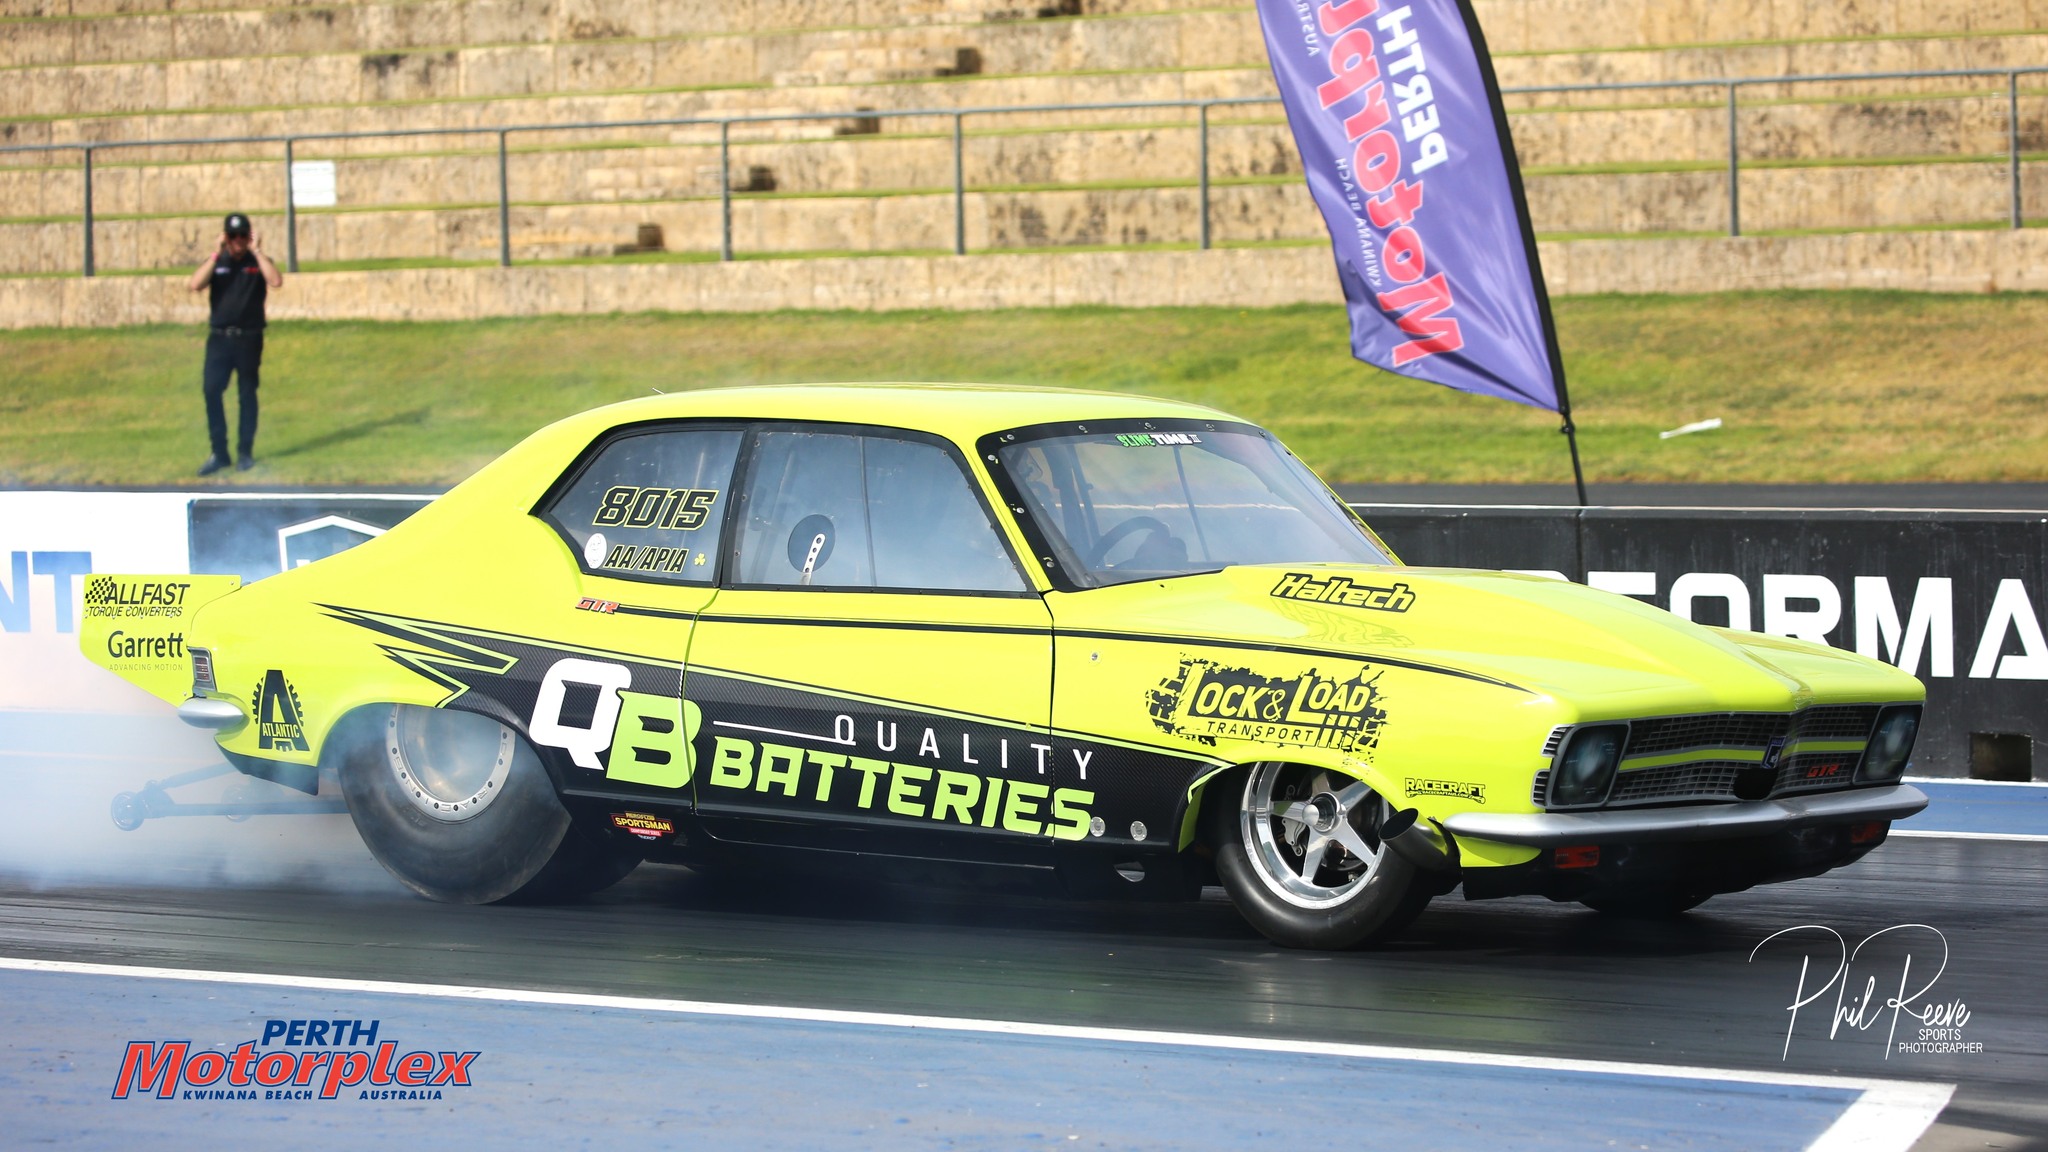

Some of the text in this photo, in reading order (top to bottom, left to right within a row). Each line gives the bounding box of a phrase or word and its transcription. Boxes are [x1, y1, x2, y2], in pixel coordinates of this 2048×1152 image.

[592, 486, 719, 530] 8015
[104, 583, 190, 605] ALLFAST
[1271, 573, 1416, 613] Haltech
[88, 606, 183, 618] TORQUE CONVERTERS
[575, 597, 620, 614] GTR
[107, 630, 183, 658] Garrett
[109, 663, 183, 671] ADVANCING MOTION
[262, 722, 300, 738] ATLANTIC
[529, 657, 702, 789] QB
[1206, 721, 1314, 743] TRANSPORT
[834, 714, 1093, 780] QUALITY
[709, 735, 1096, 841] BATTERIES
[1405, 778, 1486, 797] RACECRAFT
[614, 817, 671, 831] SPORTSMAN
